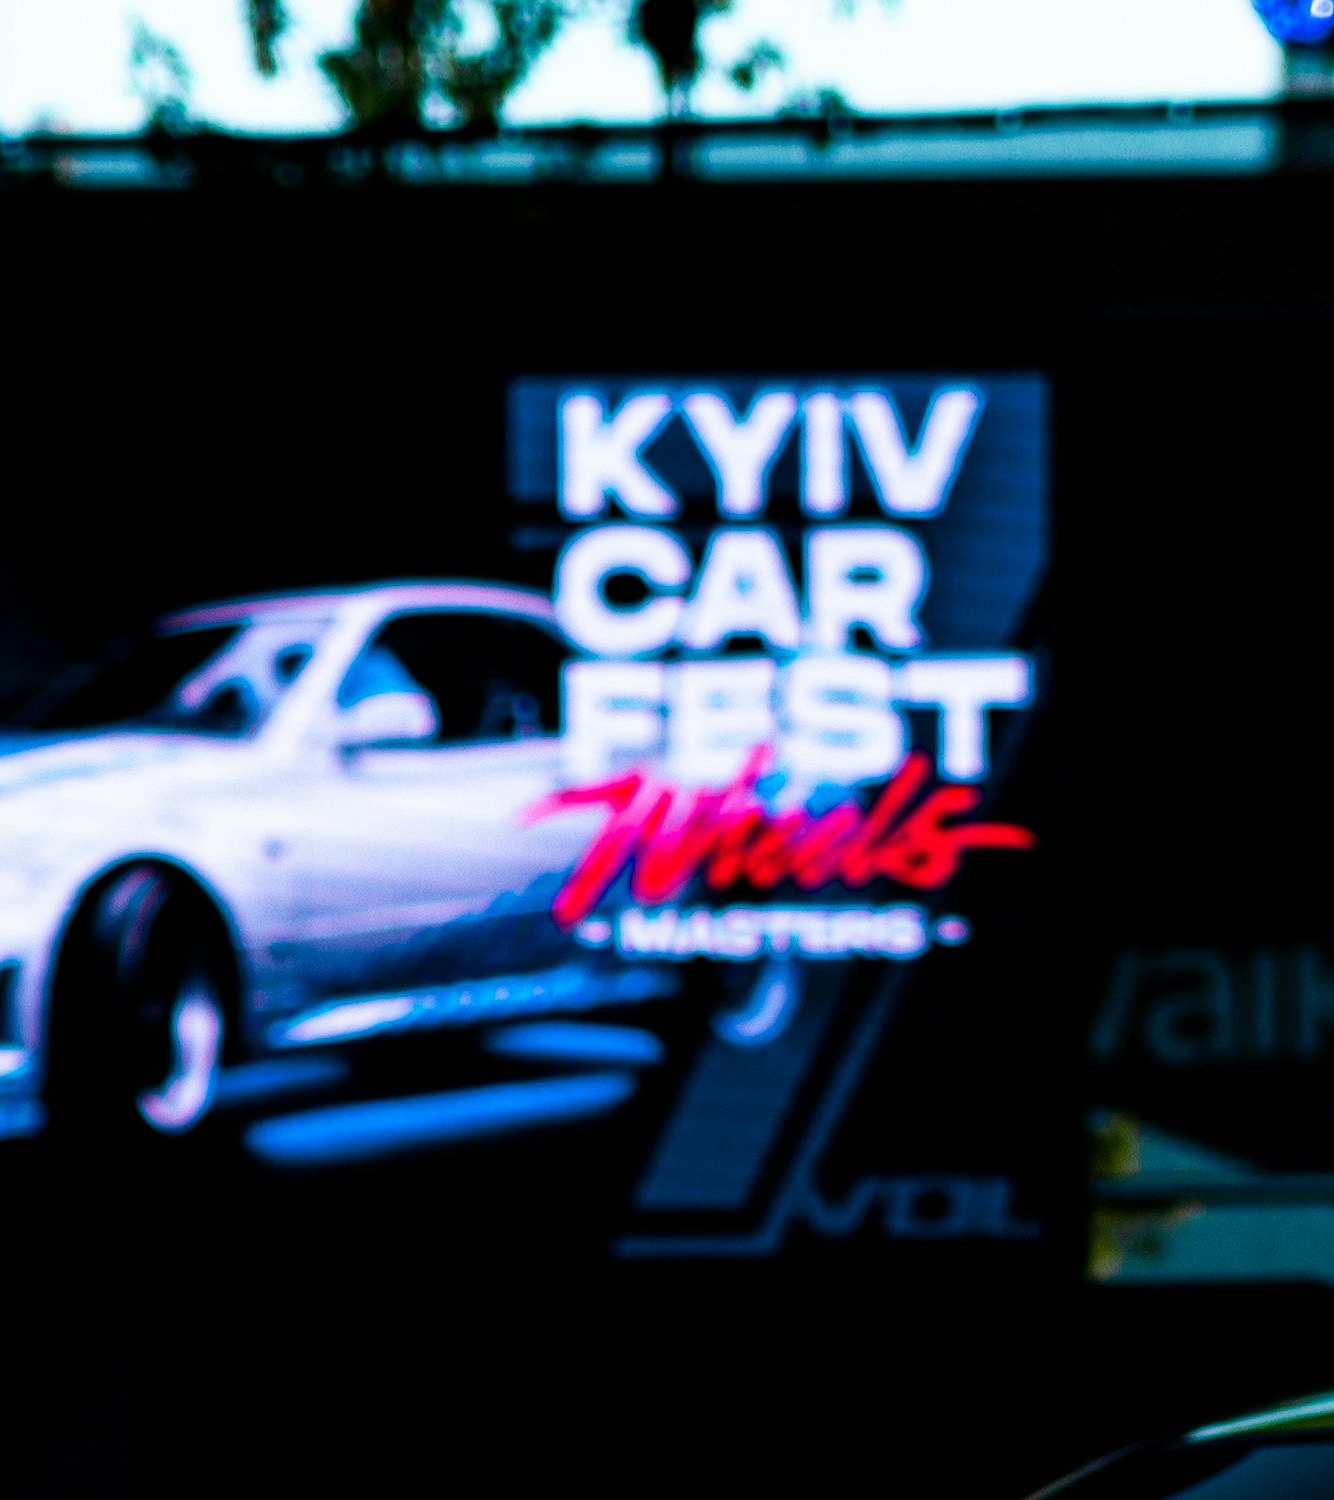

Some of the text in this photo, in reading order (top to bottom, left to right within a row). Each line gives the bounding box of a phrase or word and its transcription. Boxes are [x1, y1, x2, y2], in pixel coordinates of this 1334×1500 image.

[560, 388, 985, 518] KYIV
[553, 523, 929, 656] CAR
[560, 652, 1031, 782] FEST
[614, 907, 931, 960] MASTERS
